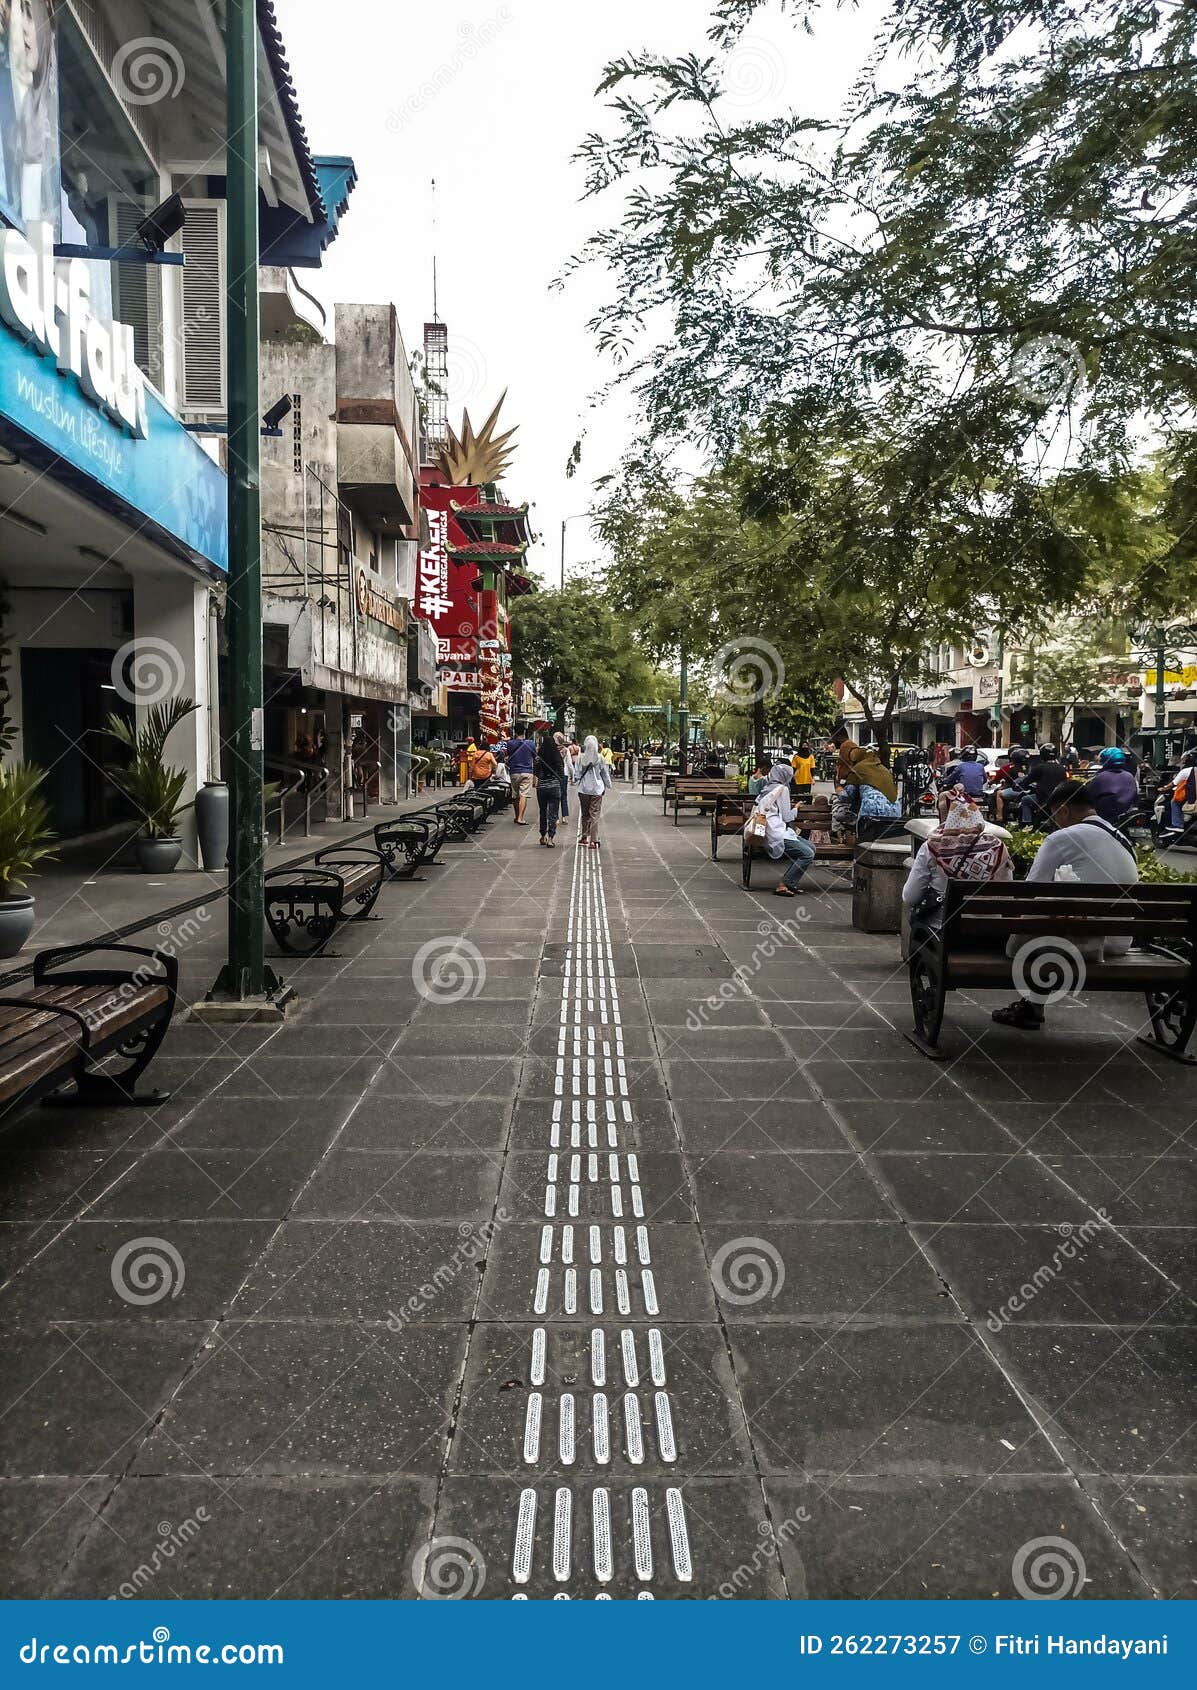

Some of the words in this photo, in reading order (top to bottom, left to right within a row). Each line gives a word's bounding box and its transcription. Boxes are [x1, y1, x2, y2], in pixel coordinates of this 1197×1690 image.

[17, 371, 76, 441] muslim
[79, 410, 123, 478] lifestyle
[419, 508, 455, 620] #KEREN
[438, 651, 471, 662] ayana
